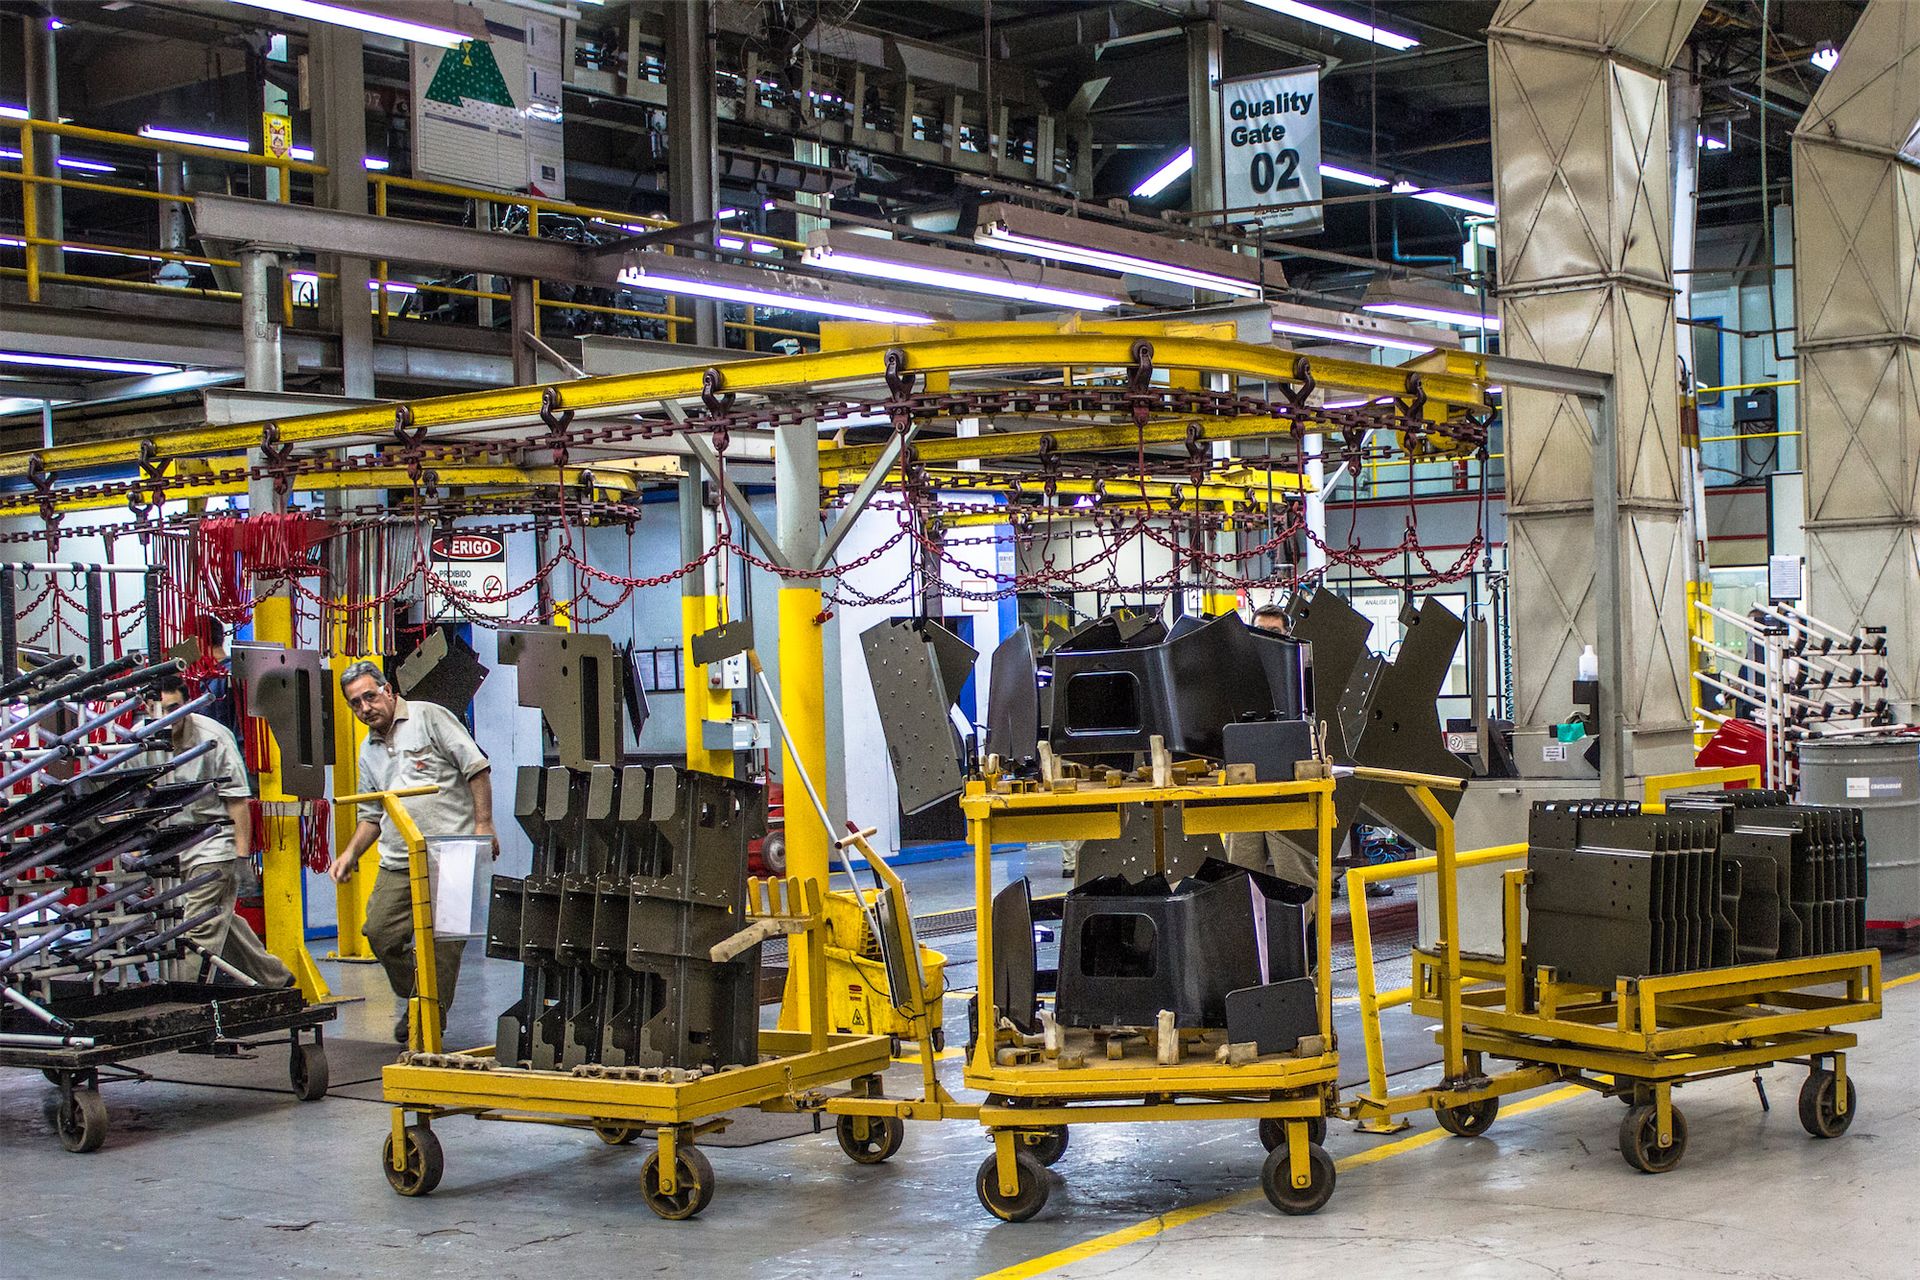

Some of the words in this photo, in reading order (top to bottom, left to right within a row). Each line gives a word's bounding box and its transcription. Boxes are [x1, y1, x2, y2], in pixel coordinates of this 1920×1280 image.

[1230, 92, 1313, 120] Quality
[1231, 123, 1286, 147] Gate
[1250, 148, 1300, 194] 02
[443, 540, 491, 554] ERIGO
[439, 570, 472, 578] PROIBIDO
